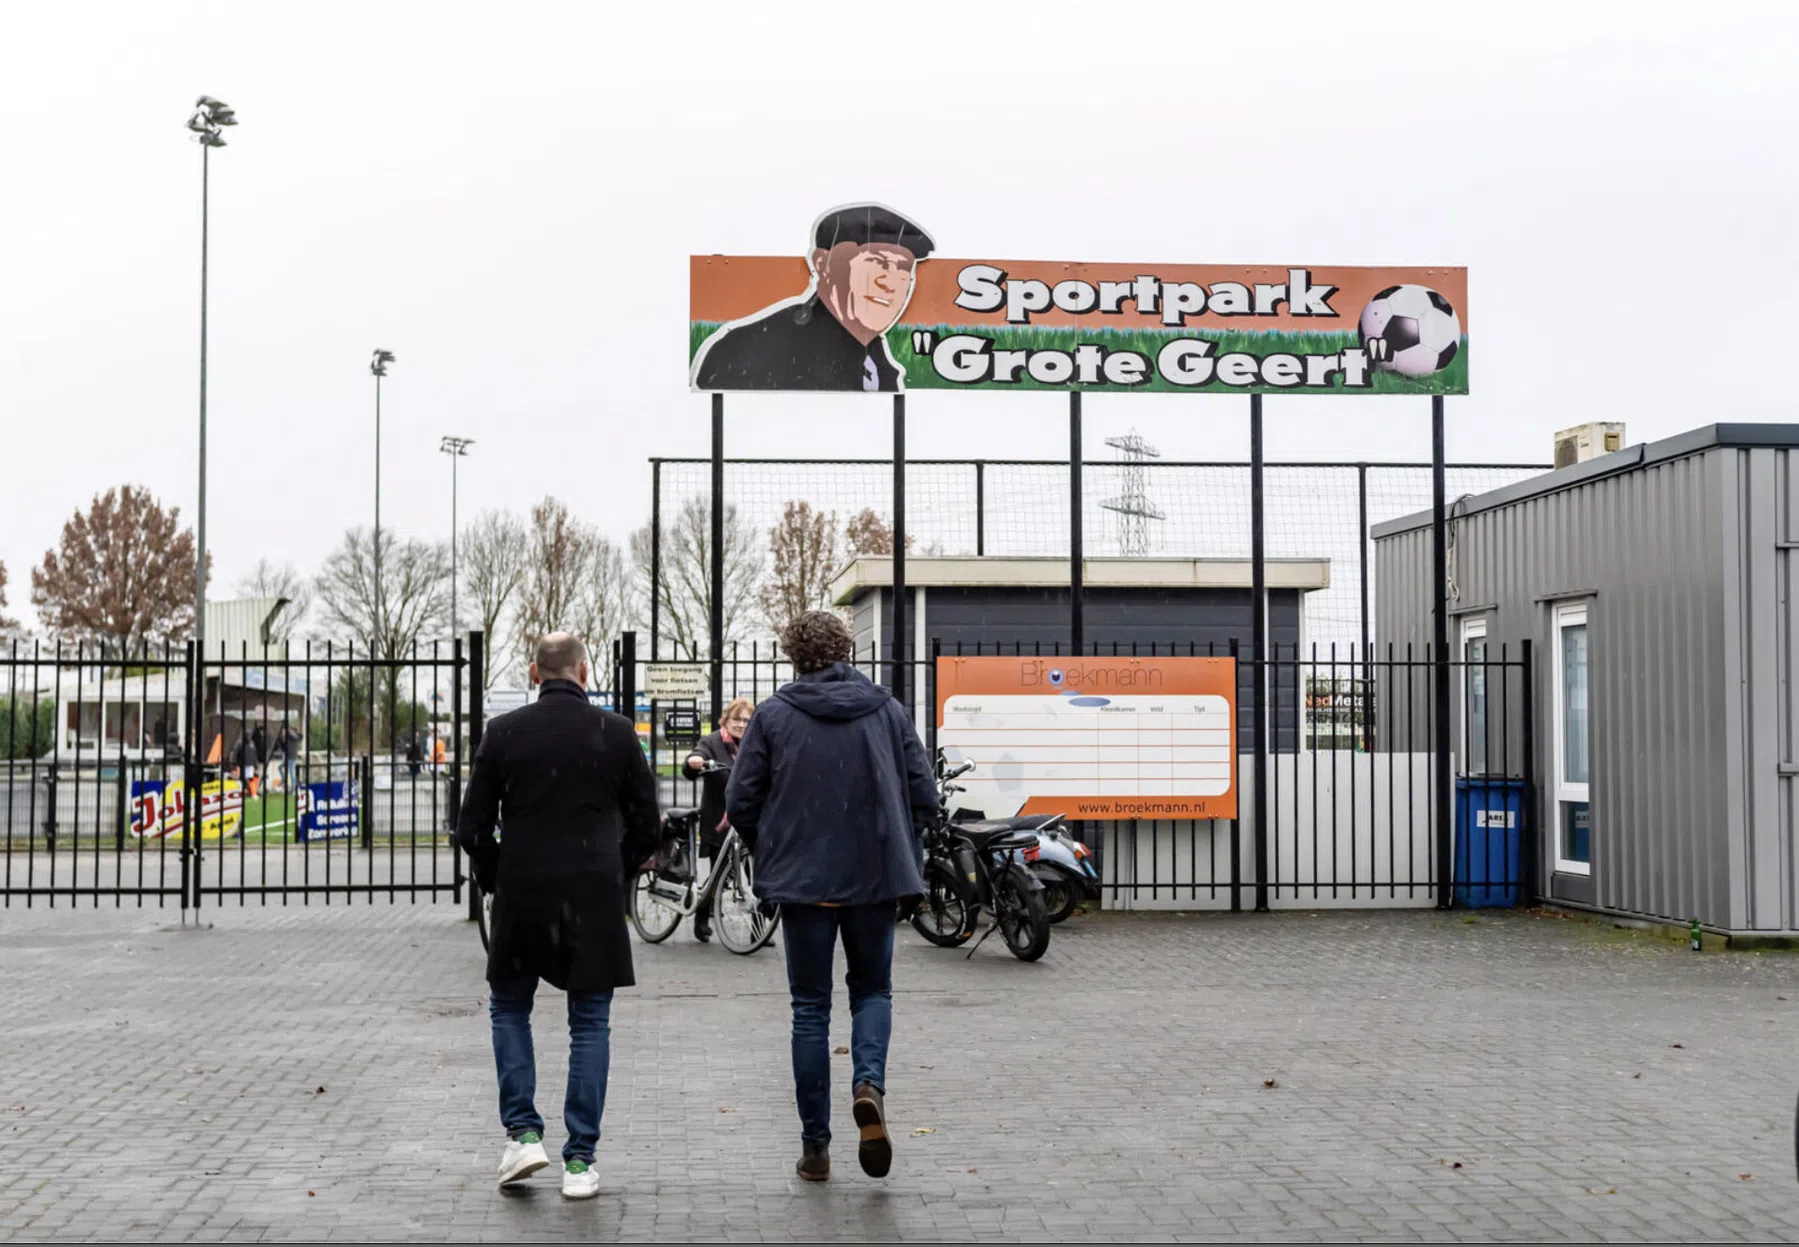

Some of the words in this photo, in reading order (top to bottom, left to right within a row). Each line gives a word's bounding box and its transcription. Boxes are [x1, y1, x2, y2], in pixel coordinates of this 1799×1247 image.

[955, 265, 1340, 327] Sportpark
[911, 331, 1154, 388] "Grote
[1157, 334, 1390, 390] Geert"
[647, 665, 668, 673] Geen
[670, 666, 702, 674] toegang
[1021, 662, 1163, 687] Broekmann
[1078, 800, 1206, 814] www.broekmann.nl
